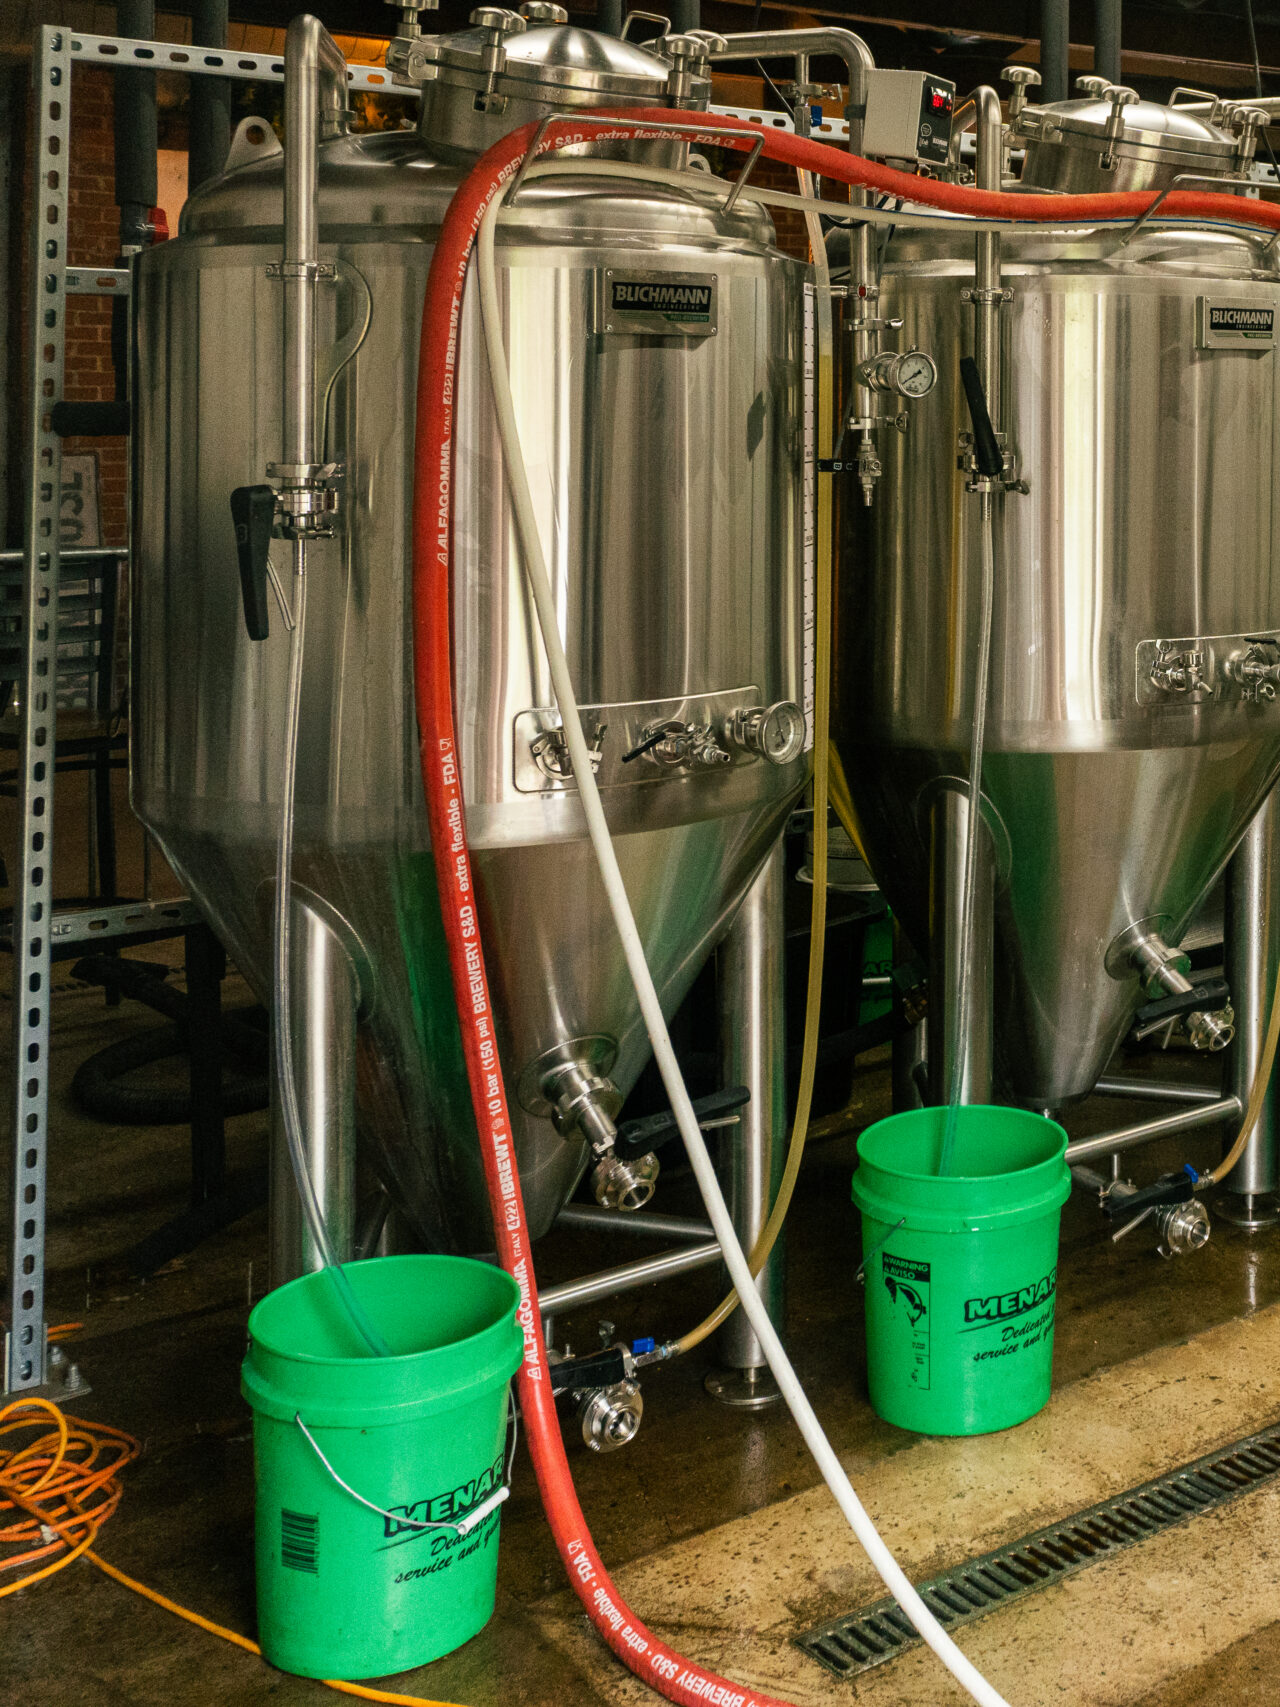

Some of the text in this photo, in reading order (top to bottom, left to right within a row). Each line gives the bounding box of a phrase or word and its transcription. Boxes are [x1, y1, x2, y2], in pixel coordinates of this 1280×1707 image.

[555, 133, 584, 149] S&D
[595, 130, 630, 140] extra
[634, 128, 682, 141] flexible
[694, 134, 722, 147] FDA
[462, 233, 474, 258] bar
[457, 260, 467, 278] 10
[614, 284, 709, 305] BLICHMANN
[1211, 310, 1273, 325] BLICHMANN
[443, 374, 454, 404] 422
[443, 408, 452, 435] ITALY
[437, 438, 451, 551] ALFAGOMMA
[442, 751, 457, 787] FDA
[447, 798, 465, 853] flexible
[455, 854, 470, 893] extra
[459, 905, 476, 938] S&D
[464, 941, 488, 1015] BREWERY
[475, 1016, 491, 1039] psi)
[479, 1039, 496, 1072] (150
[486, 1073, 500, 1099] bar
[487, 1098, 503, 1118] 10
[505, 1200, 521, 1231] 422
[511, 1232, 523, 1257] ITALY
[889, 1257, 929, 1272] WARNING
[890, 1267, 915, 1280] AVISO
[513, 1257, 540, 1365] ALFAGOMMA
[973, 1327, 1042, 1362] service and
[394, 1556, 453, 1584] service
[457, 1531, 483, 1562] and
[572, 1550, 597, 1584] FDA
[592, 1586, 627, 1631] flexible
[619, 1624, 650, 1655] extra
[650, 1653, 680, 1679] S&D
[675, 1669, 746, 1707] BREWERY
